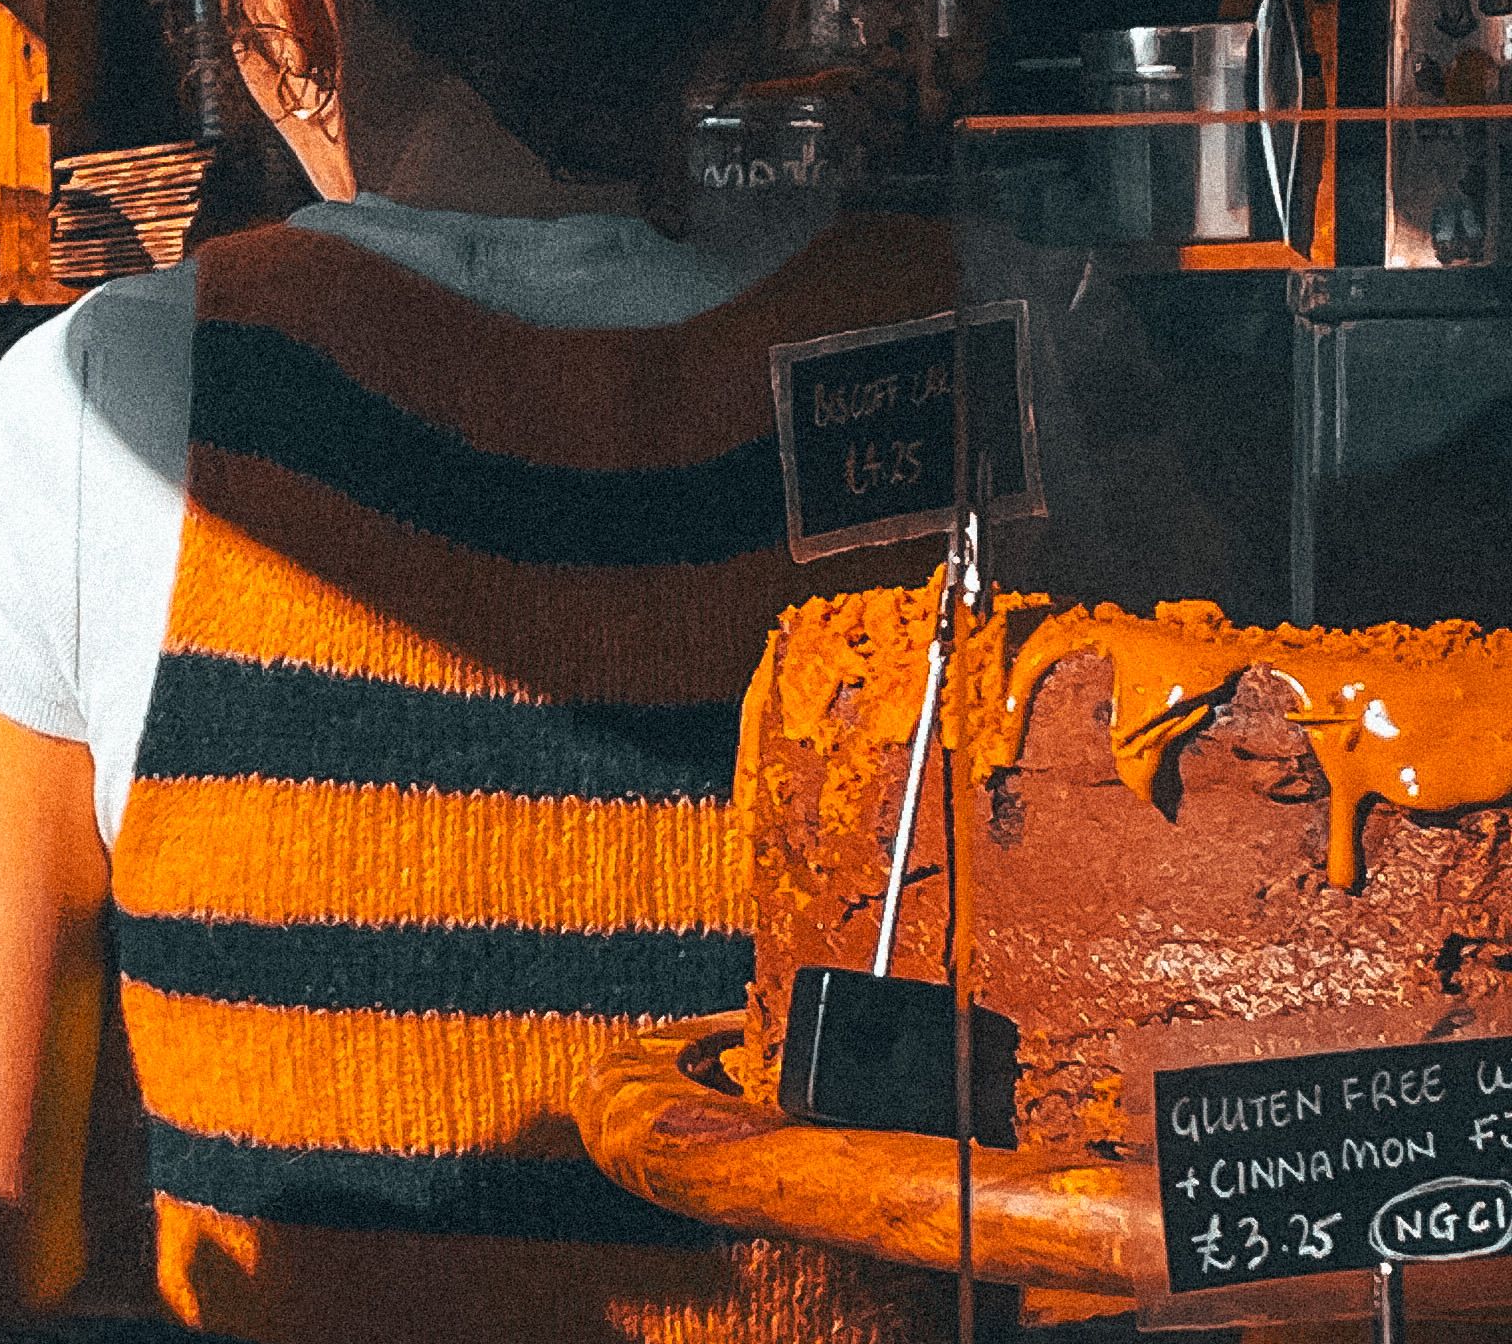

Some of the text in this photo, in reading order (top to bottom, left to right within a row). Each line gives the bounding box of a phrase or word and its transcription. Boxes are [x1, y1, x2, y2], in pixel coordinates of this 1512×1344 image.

[1171, 1083, 1321, 1143] GLUTEN
[1342, 1064, 1445, 1111] FREE
[1191, 1198, 1505, 1273] £3.25 NGCI
